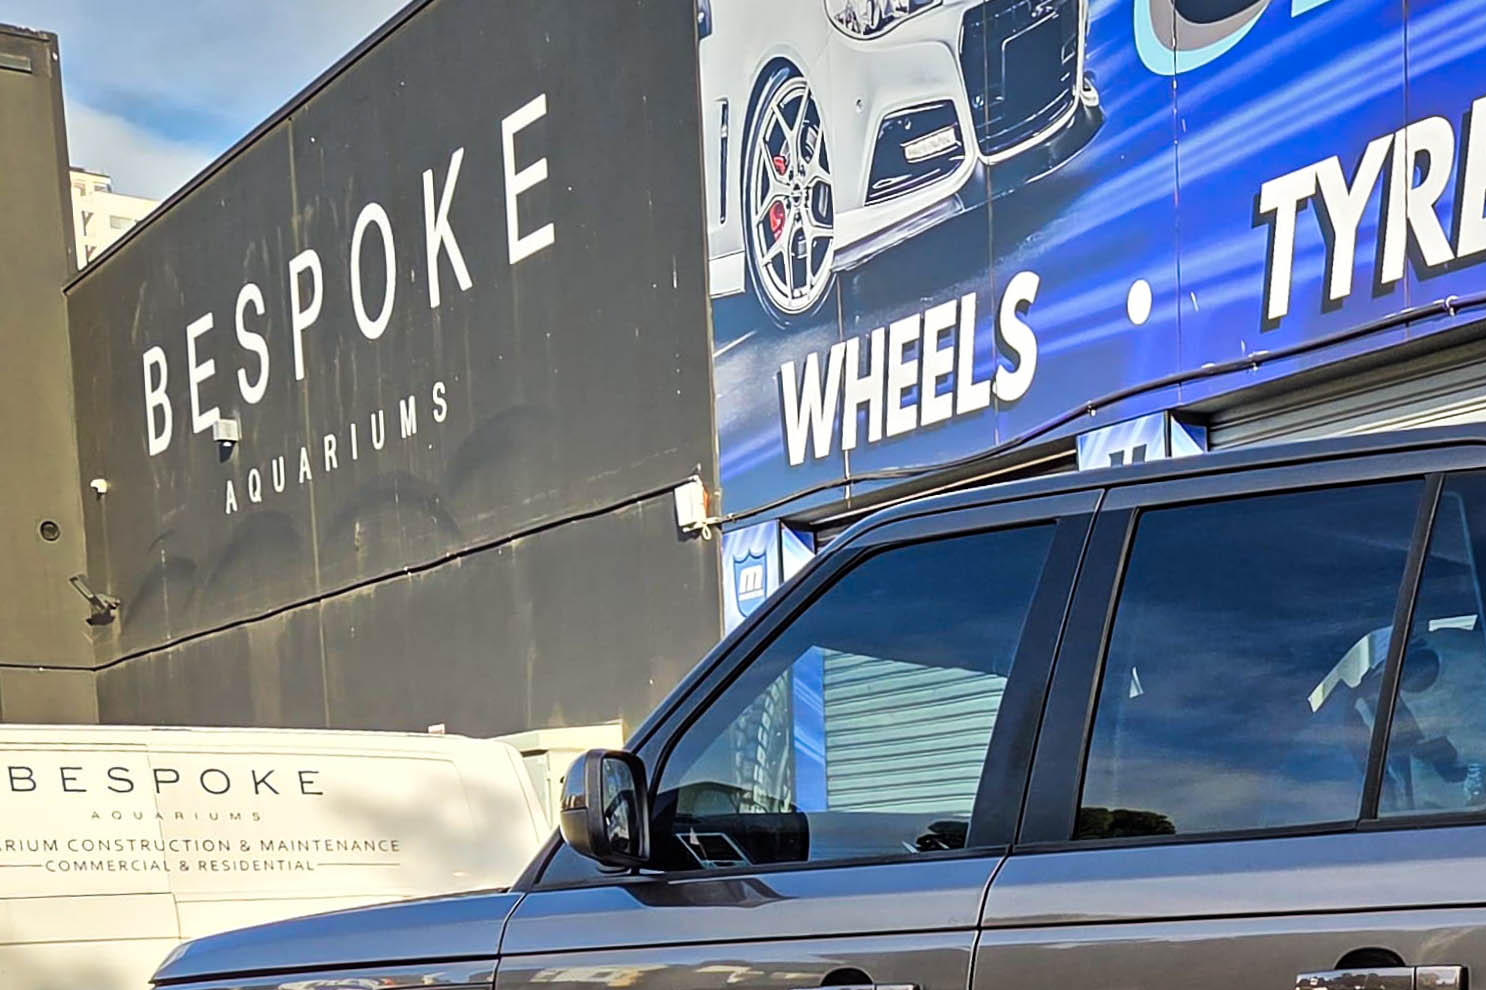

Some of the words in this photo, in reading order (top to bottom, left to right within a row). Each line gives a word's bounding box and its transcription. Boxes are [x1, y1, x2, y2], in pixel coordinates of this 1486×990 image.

[143, 92, 555, 456] BESPOKE
[778, 270, 1041, 467] WHEELS
[225, 382, 447, 514] AQUARIUMS
[8, 766, 324, 796] BESPOKE
[91, 810, 261, 822] AQUARIUMS
[0, 839, 59, 852] RIUM
[67, 839, 231, 852] CONSTRUCTION
[239, 840, 251, 852] &
[260, 839, 400, 852] MAINTENANCE
[45, 859, 171, 872] COMMERCIAL
[179, 859, 190, 872] &
[198, 859, 315, 872] RESIDENTIAL
